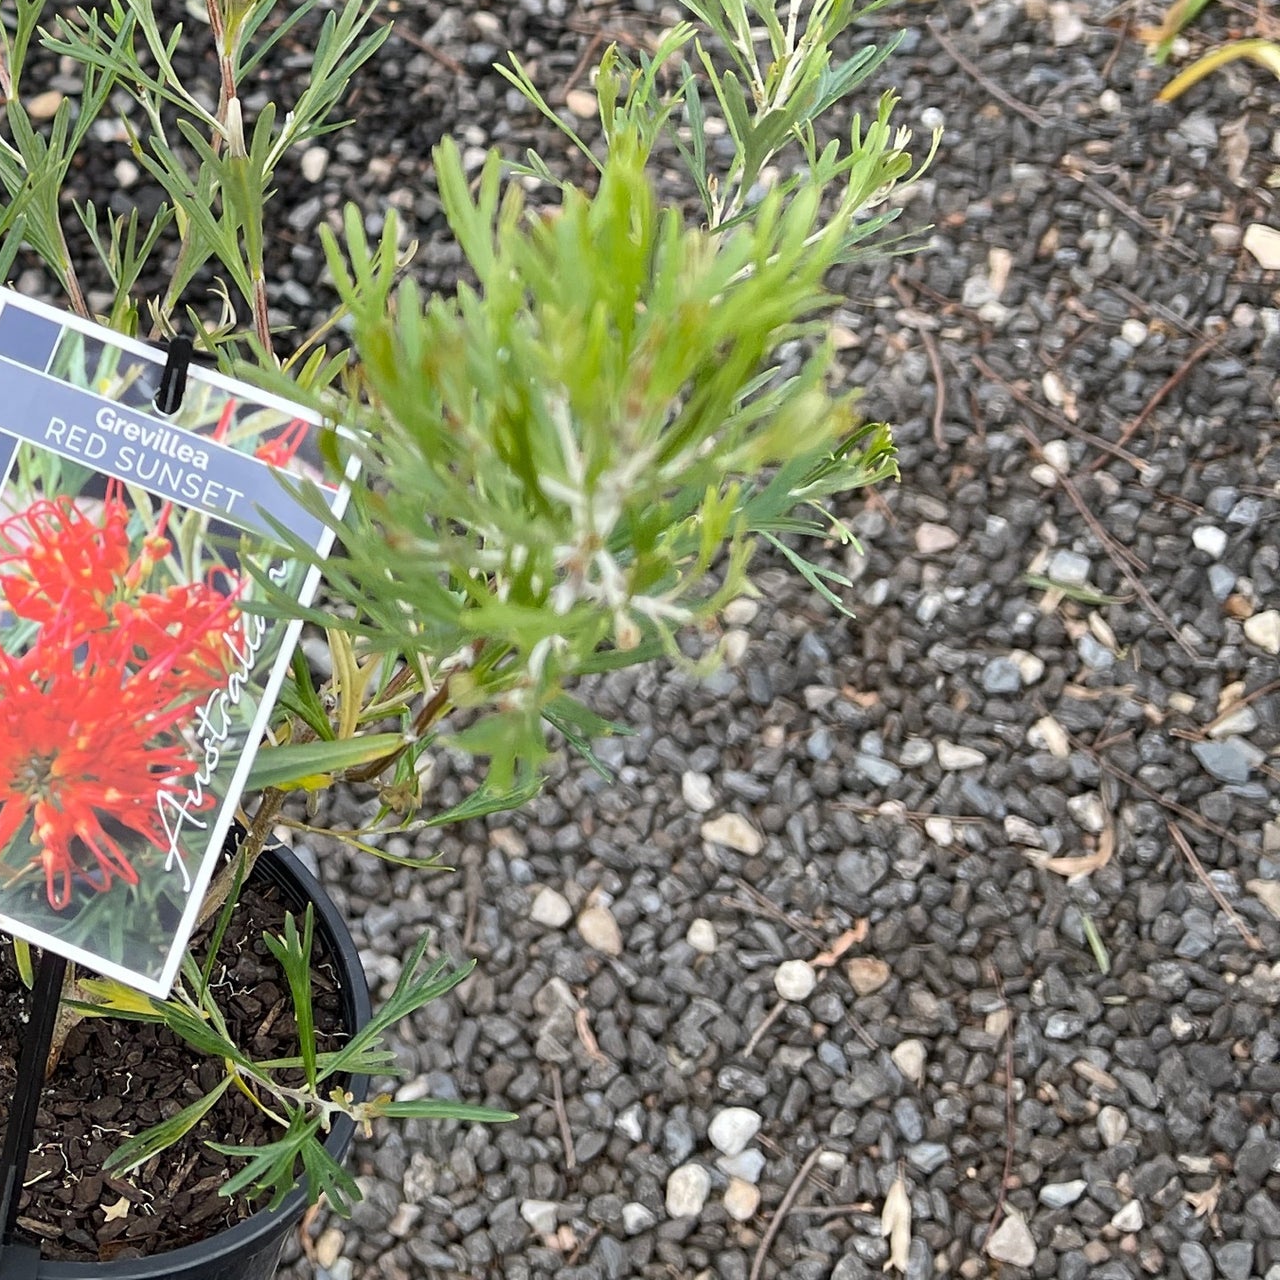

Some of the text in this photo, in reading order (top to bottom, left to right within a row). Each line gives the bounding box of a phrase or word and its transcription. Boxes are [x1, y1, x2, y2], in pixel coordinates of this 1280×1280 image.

[44, 416, 245, 514] RED SUNSET
[95, 406, 210, 471] Grevillea
